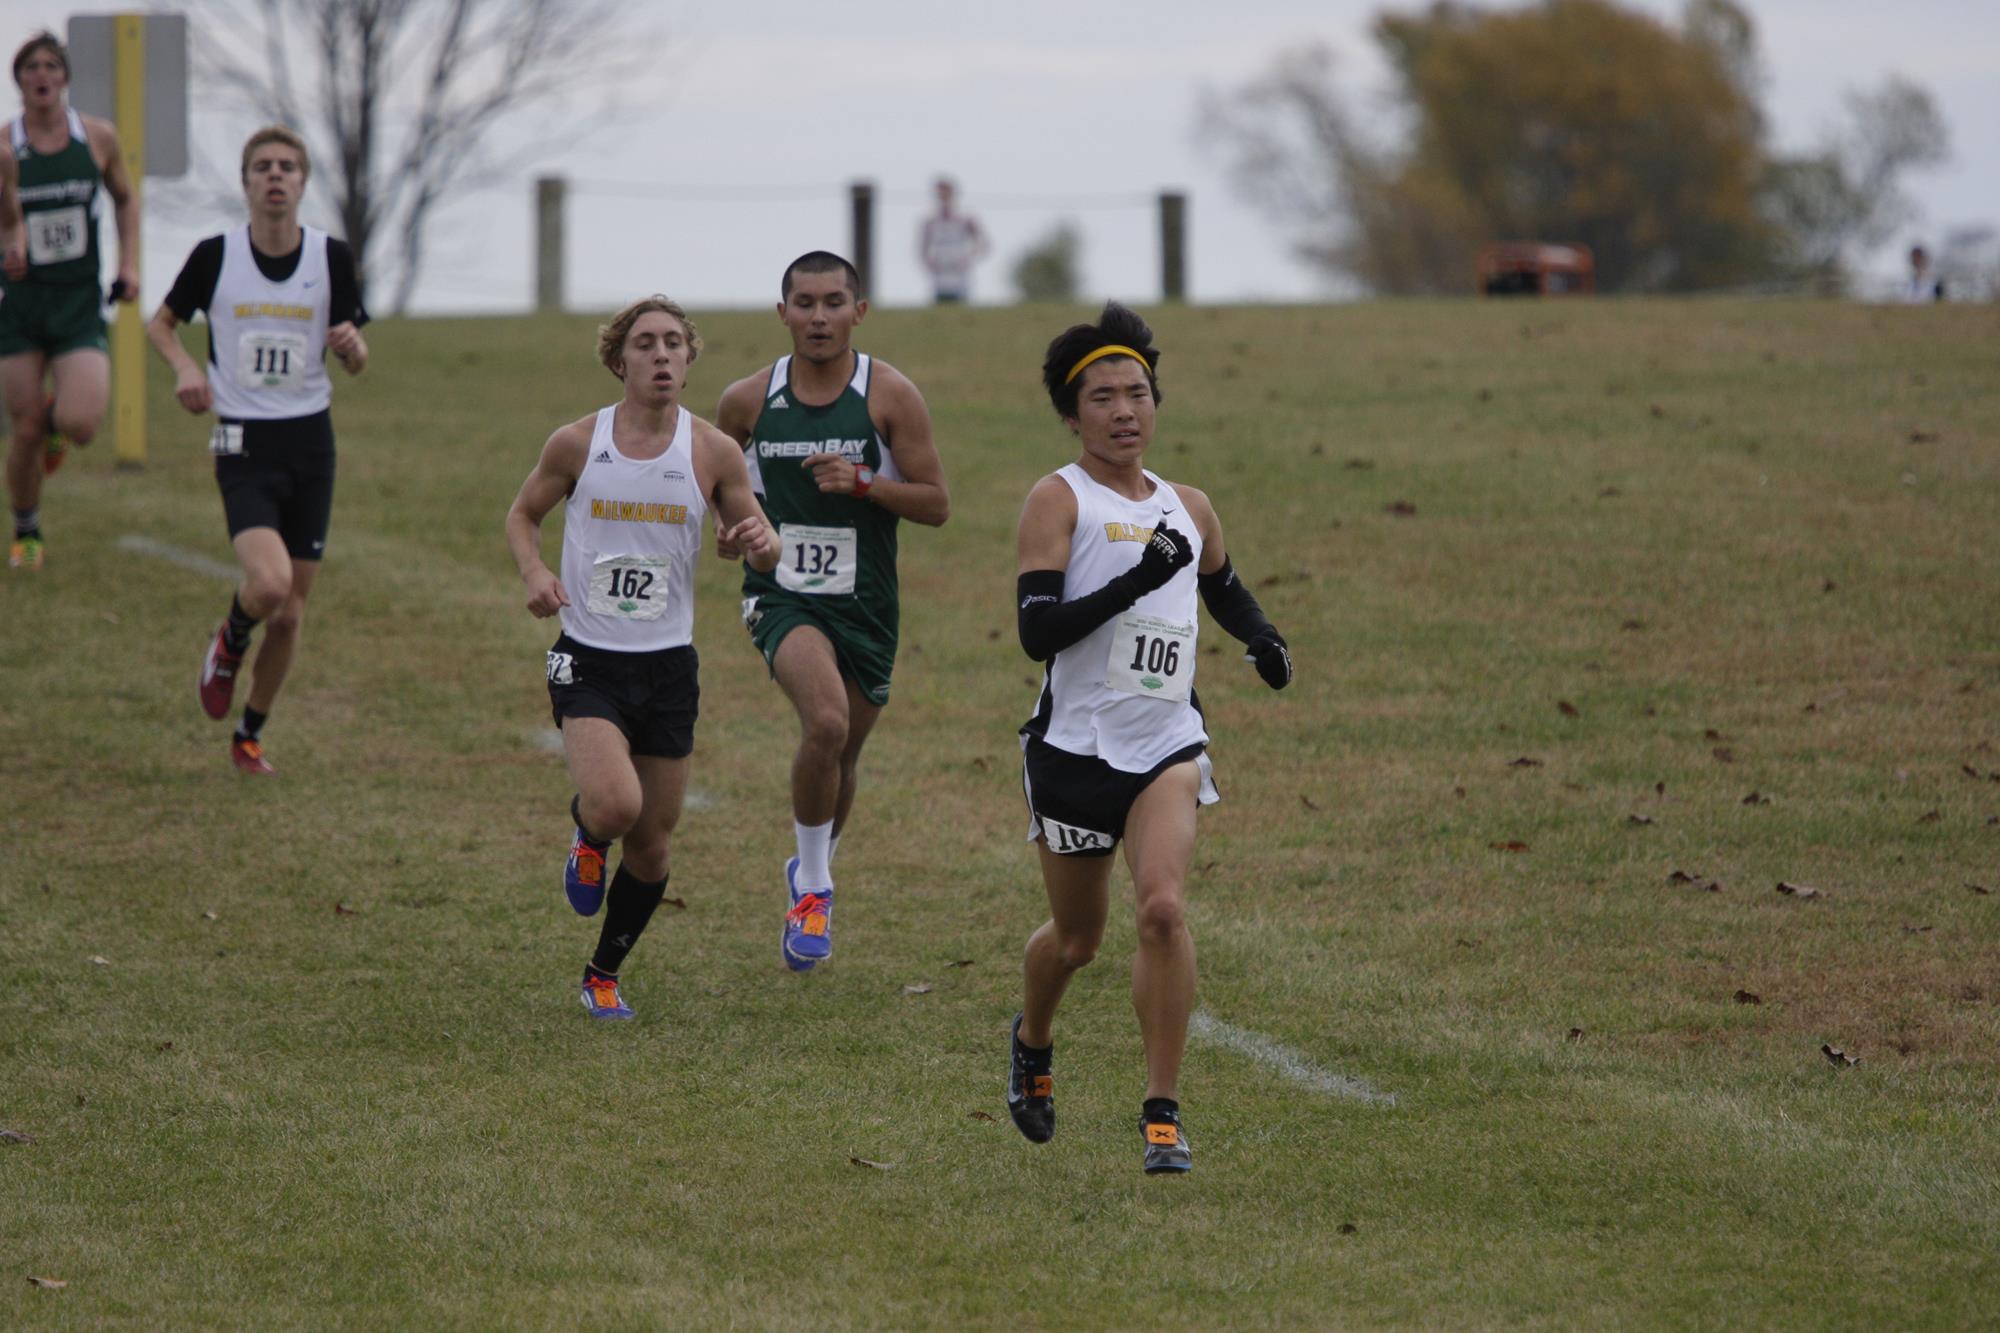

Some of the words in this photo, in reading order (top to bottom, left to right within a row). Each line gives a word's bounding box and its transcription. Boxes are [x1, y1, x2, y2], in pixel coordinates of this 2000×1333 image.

[254, 346, 289, 375] 111
[760, 440, 824, 458] GREEN
[825, 438, 868, 455] BAY
[591, 499, 688, 524] MILWAUKEE
[794, 542, 838, 576] 132
[607, 567, 654, 600] 162
[1129, 634, 1180, 677] 106
